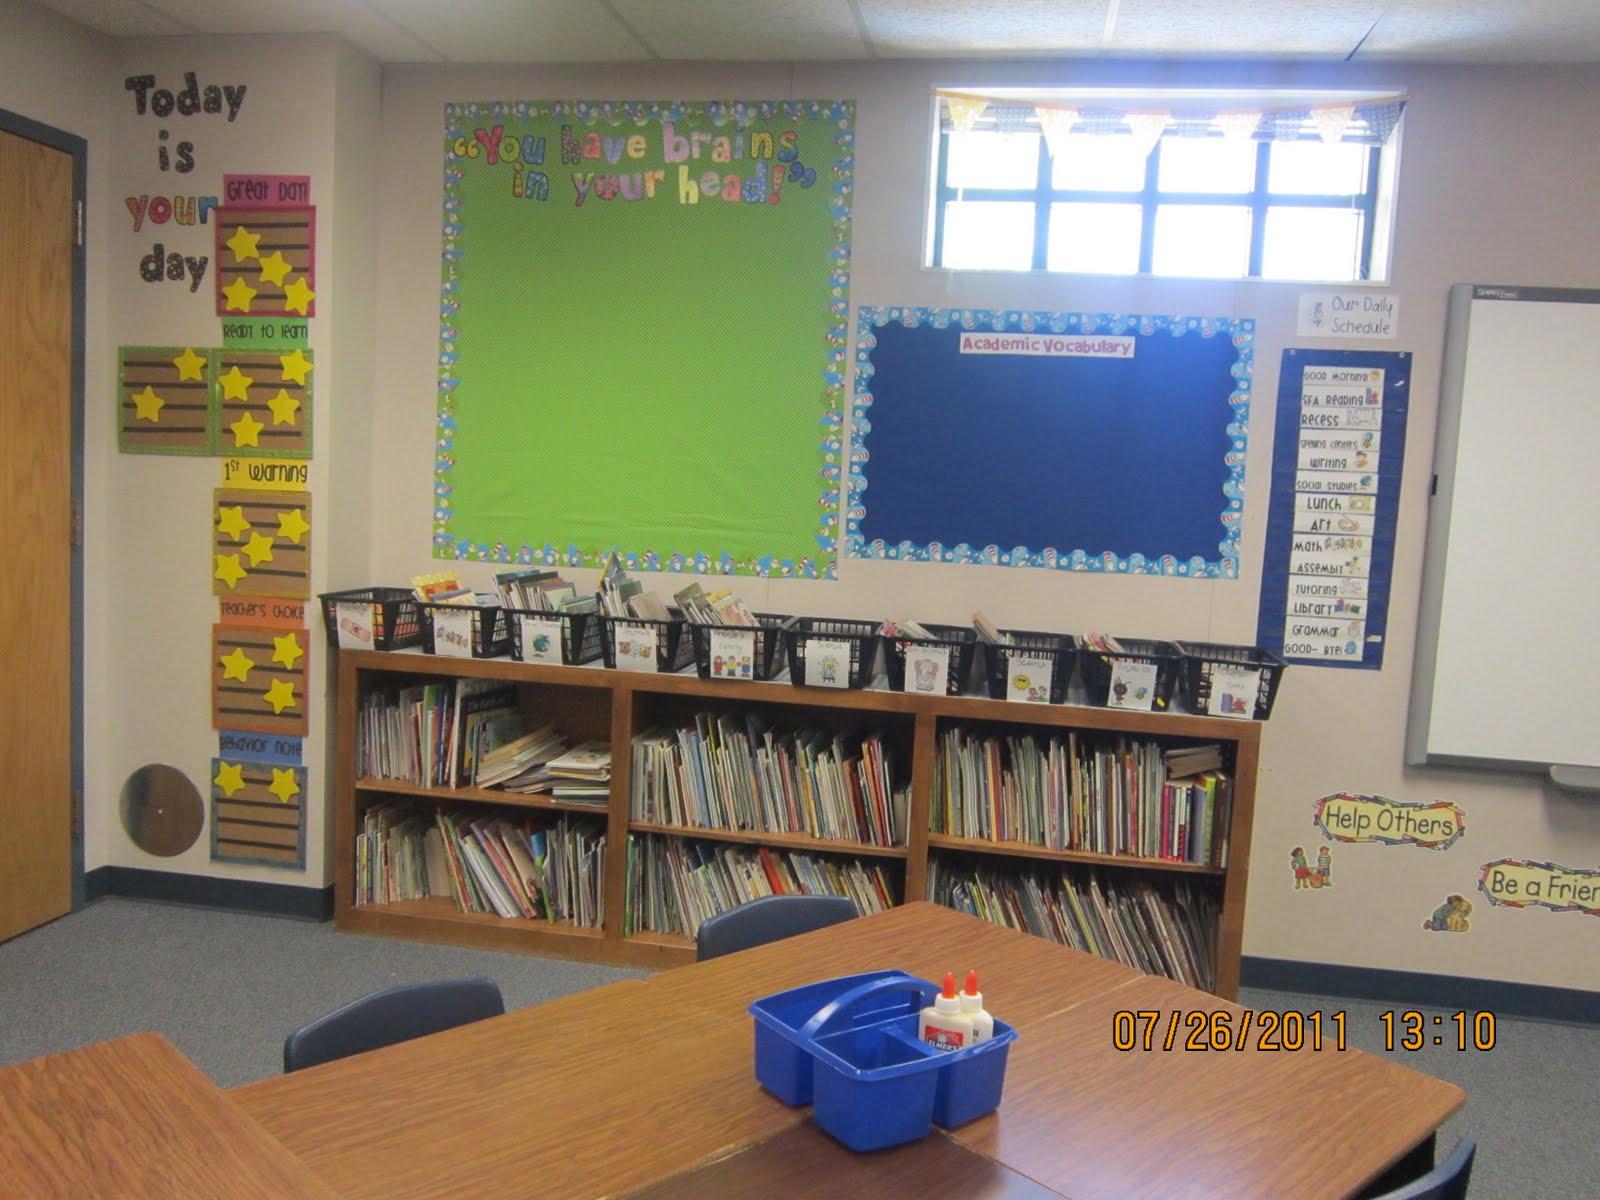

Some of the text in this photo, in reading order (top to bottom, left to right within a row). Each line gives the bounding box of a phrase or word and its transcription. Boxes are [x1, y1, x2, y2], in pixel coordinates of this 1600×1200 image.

[125, 72, 247, 122] Today
[158, 129, 195, 173] is
[560, 124, 647, 165] have
[662, 121, 799, 163] brains
[512, 161, 549, 201] in
[571, 170, 665, 207] your
[125, 195, 219, 232] your
[140, 243, 208, 293] day
[1331, 296, 1394, 318] Our Daily
[1331, 318, 1391, 335] Schedule
[962, 336, 1132, 355] Academic Vocabulary
[1307, 497, 1342, 510] Lunch
[1310, 518, 1332, 532] Art
[1294, 540, 1323, 552] Math
[1325, 805, 1454, 836] Help Others
[1491, 870, 1518, 896] Be
[1525, 881, 1541, 896] a
